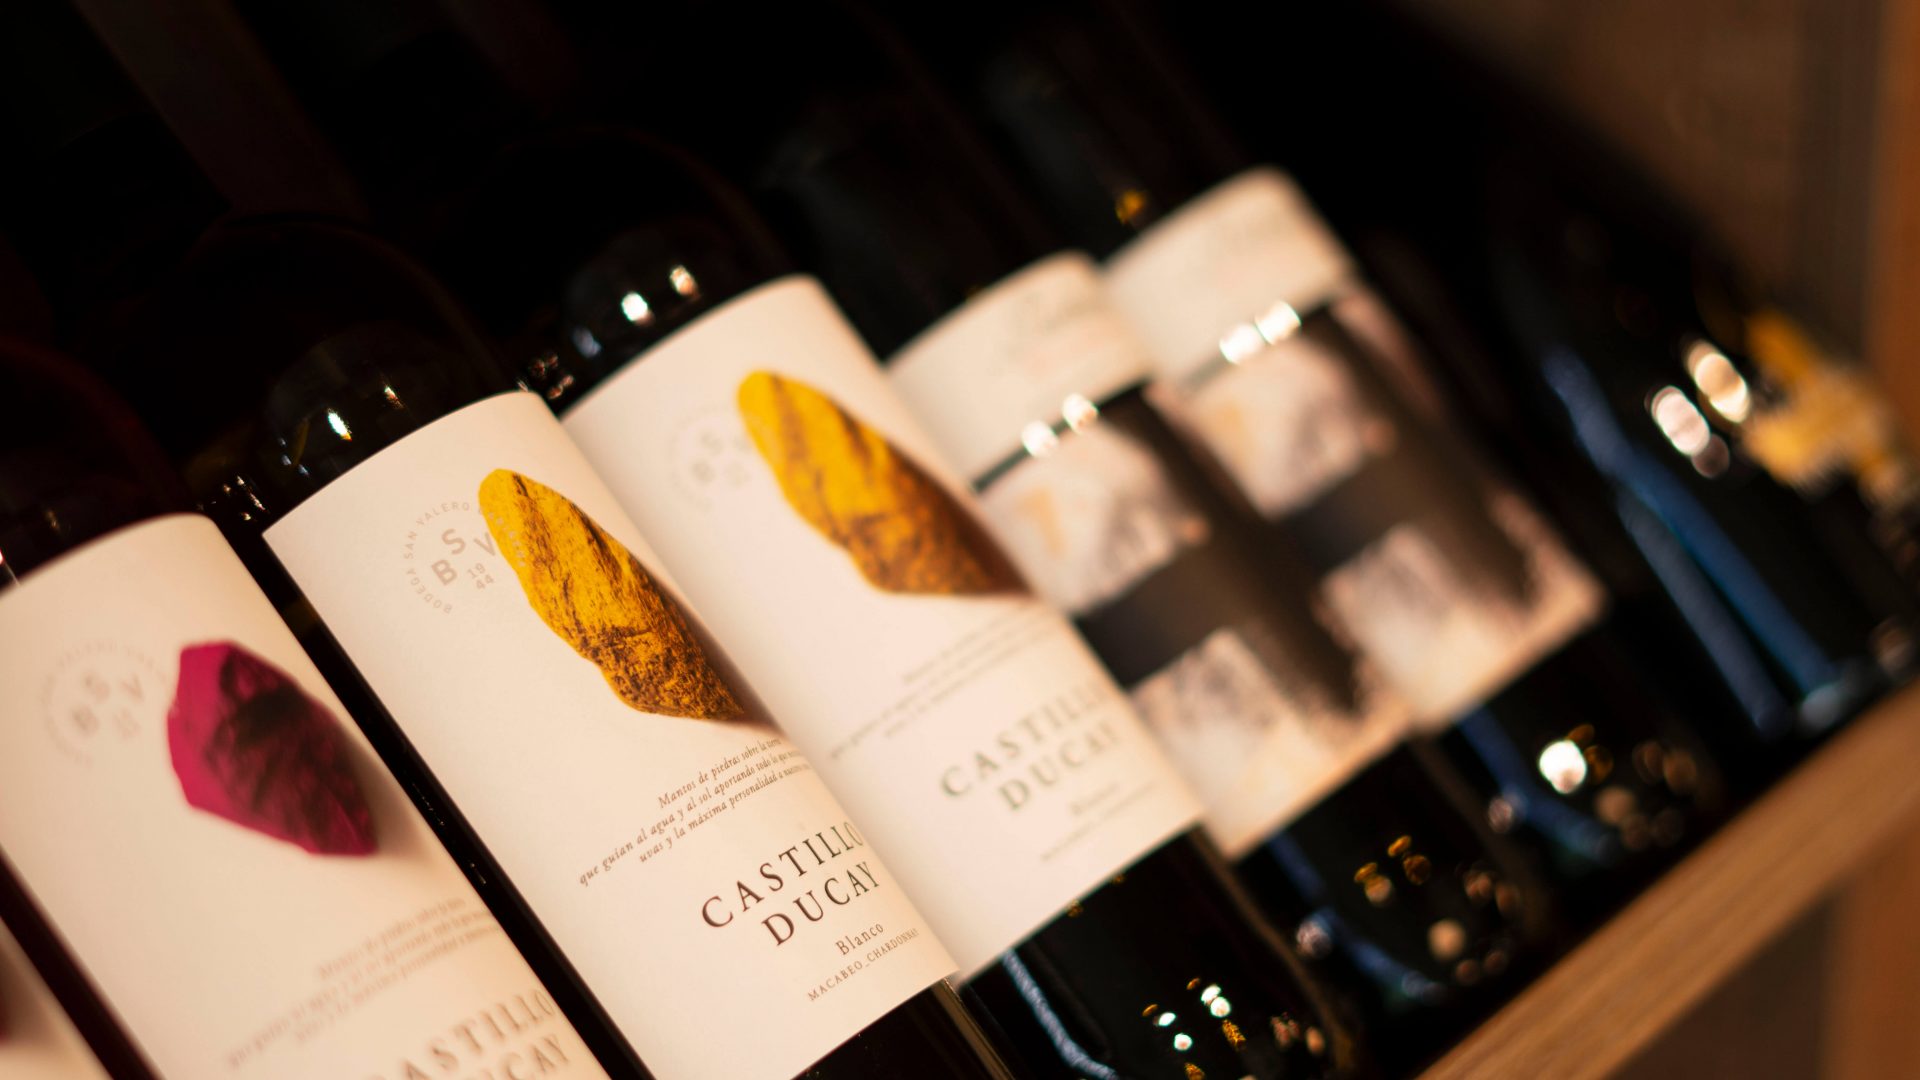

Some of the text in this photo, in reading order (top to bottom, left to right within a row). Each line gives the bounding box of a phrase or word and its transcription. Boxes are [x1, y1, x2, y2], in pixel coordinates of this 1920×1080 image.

[403, 500, 470, 614] BODEGA SAN VALERO
[639, 841, 664, 864] uvas
[666, 836, 674, 850] y
[674, 826, 686, 840] la
[687, 800, 728, 831] máxima
[728, 770, 778, 809] personalidad
[657, 780, 697, 809] Mantos
[698, 770, 709, 785] de
[711, 755, 741, 781] piedras
[741, 744, 760, 761] sobre
[579, 864, 600, 888] que
[636, 827, 649, 845] al
[650, 812, 676, 836] agua
[677, 807, 685, 822] y
[687, 796, 698, 812] al
[698, 786, 713, 805] sol
[713, 763, 756, 796] aportando
[700, 820, 865, 929] CASTILLO
[760, 860, 881, 947] DUCAY
[834, 923, 885, 956] Blanco
[364, 987, 555, 1080] ASTILLO
